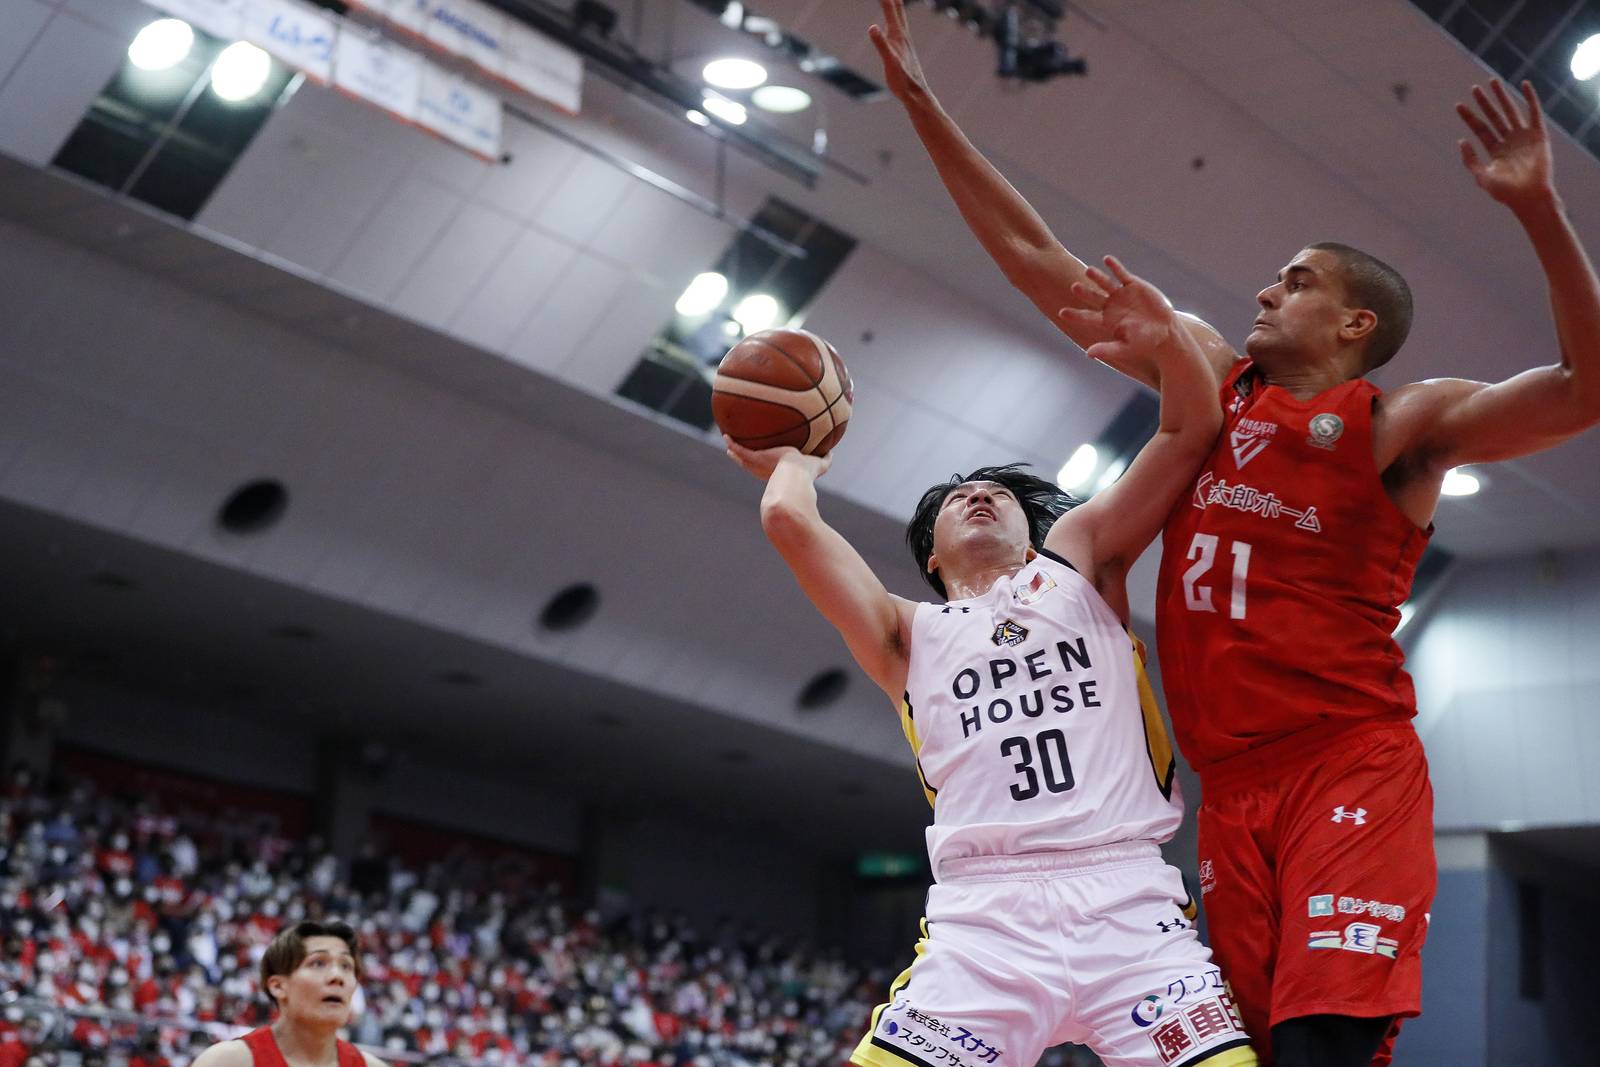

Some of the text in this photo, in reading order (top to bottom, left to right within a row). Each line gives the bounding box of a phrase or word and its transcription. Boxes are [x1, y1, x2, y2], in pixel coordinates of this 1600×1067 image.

[1182, 533, 1252, 620] 21
[952, 637, 1092, 700] OPEN
[960, 680, 1102, 738] HOUSE
[1000, 728, 1075, 802] 30
